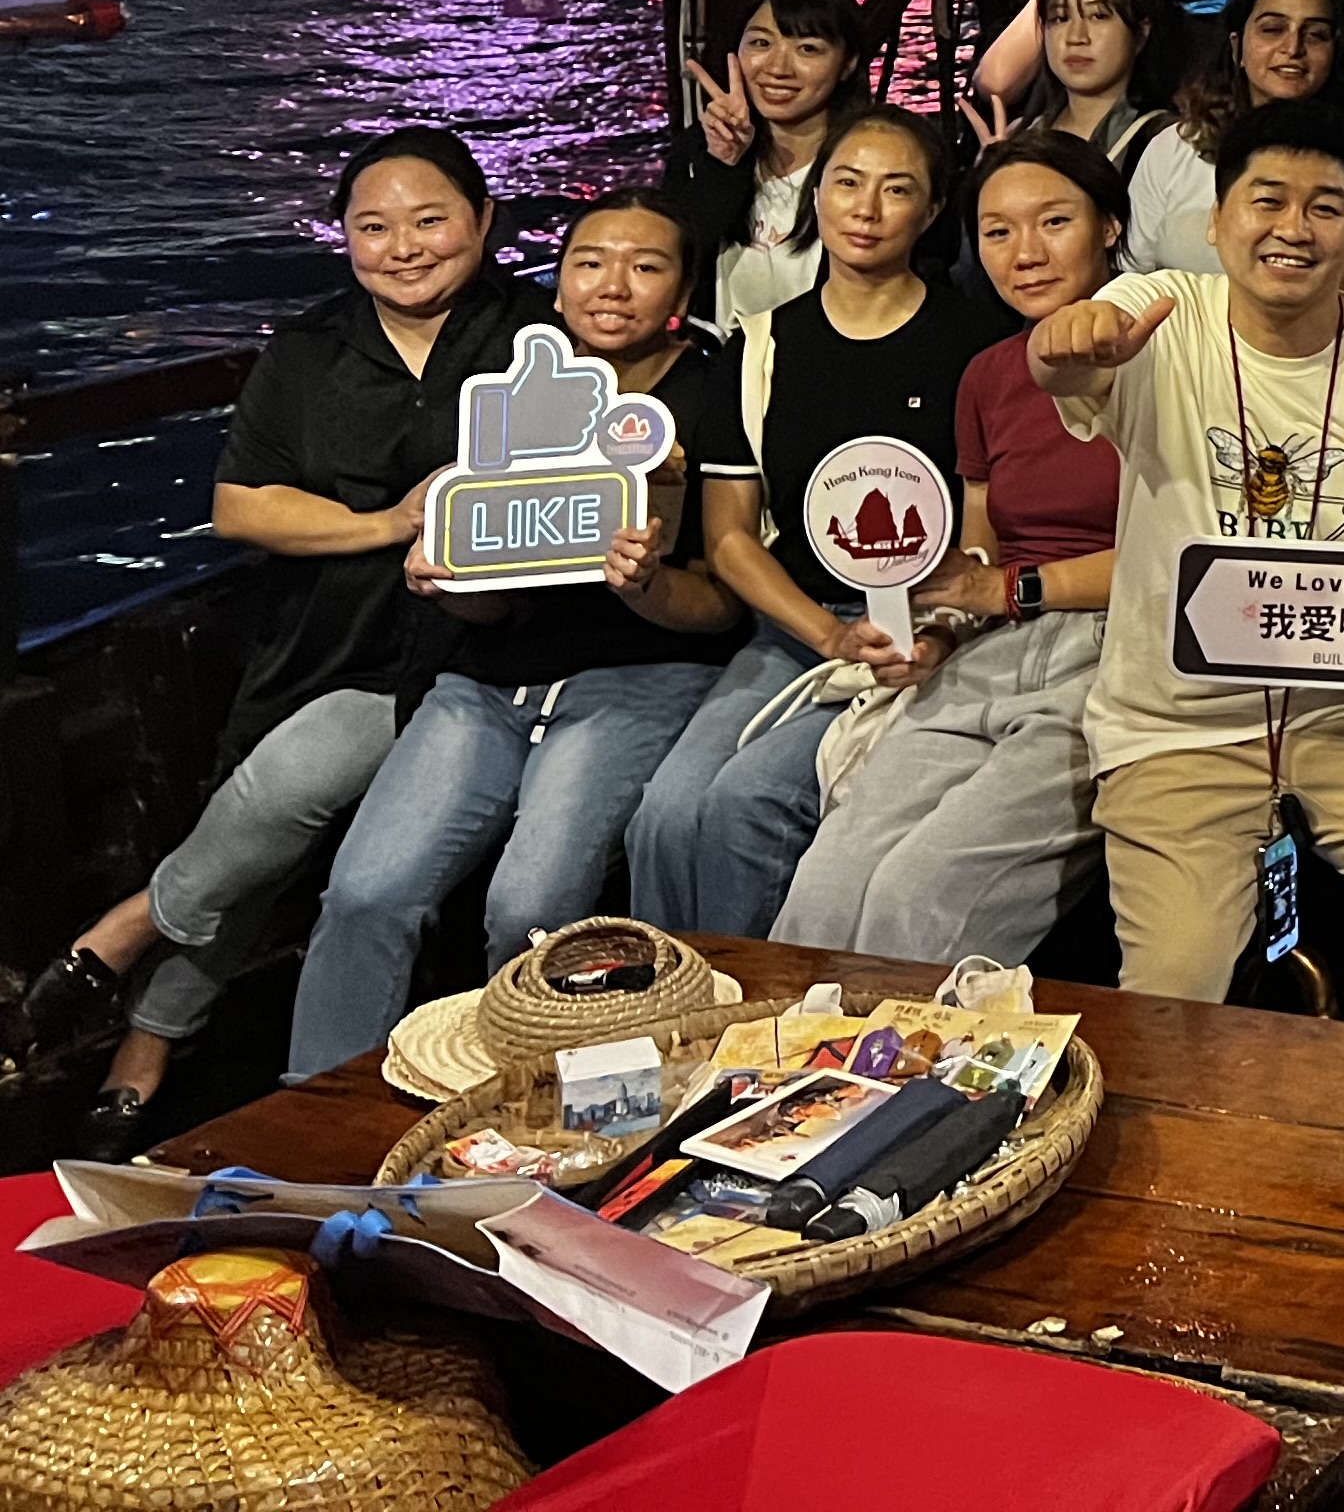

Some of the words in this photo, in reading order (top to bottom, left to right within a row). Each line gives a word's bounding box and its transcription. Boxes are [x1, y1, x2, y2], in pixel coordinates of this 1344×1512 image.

[823, 472, 857, 491] Hong
[859, 466, 892, 479] Kong
[894, 466, 921, 484] Icon
[472, 495, 601, 551] LIKE
[1248, 570, 1283, 589] We
